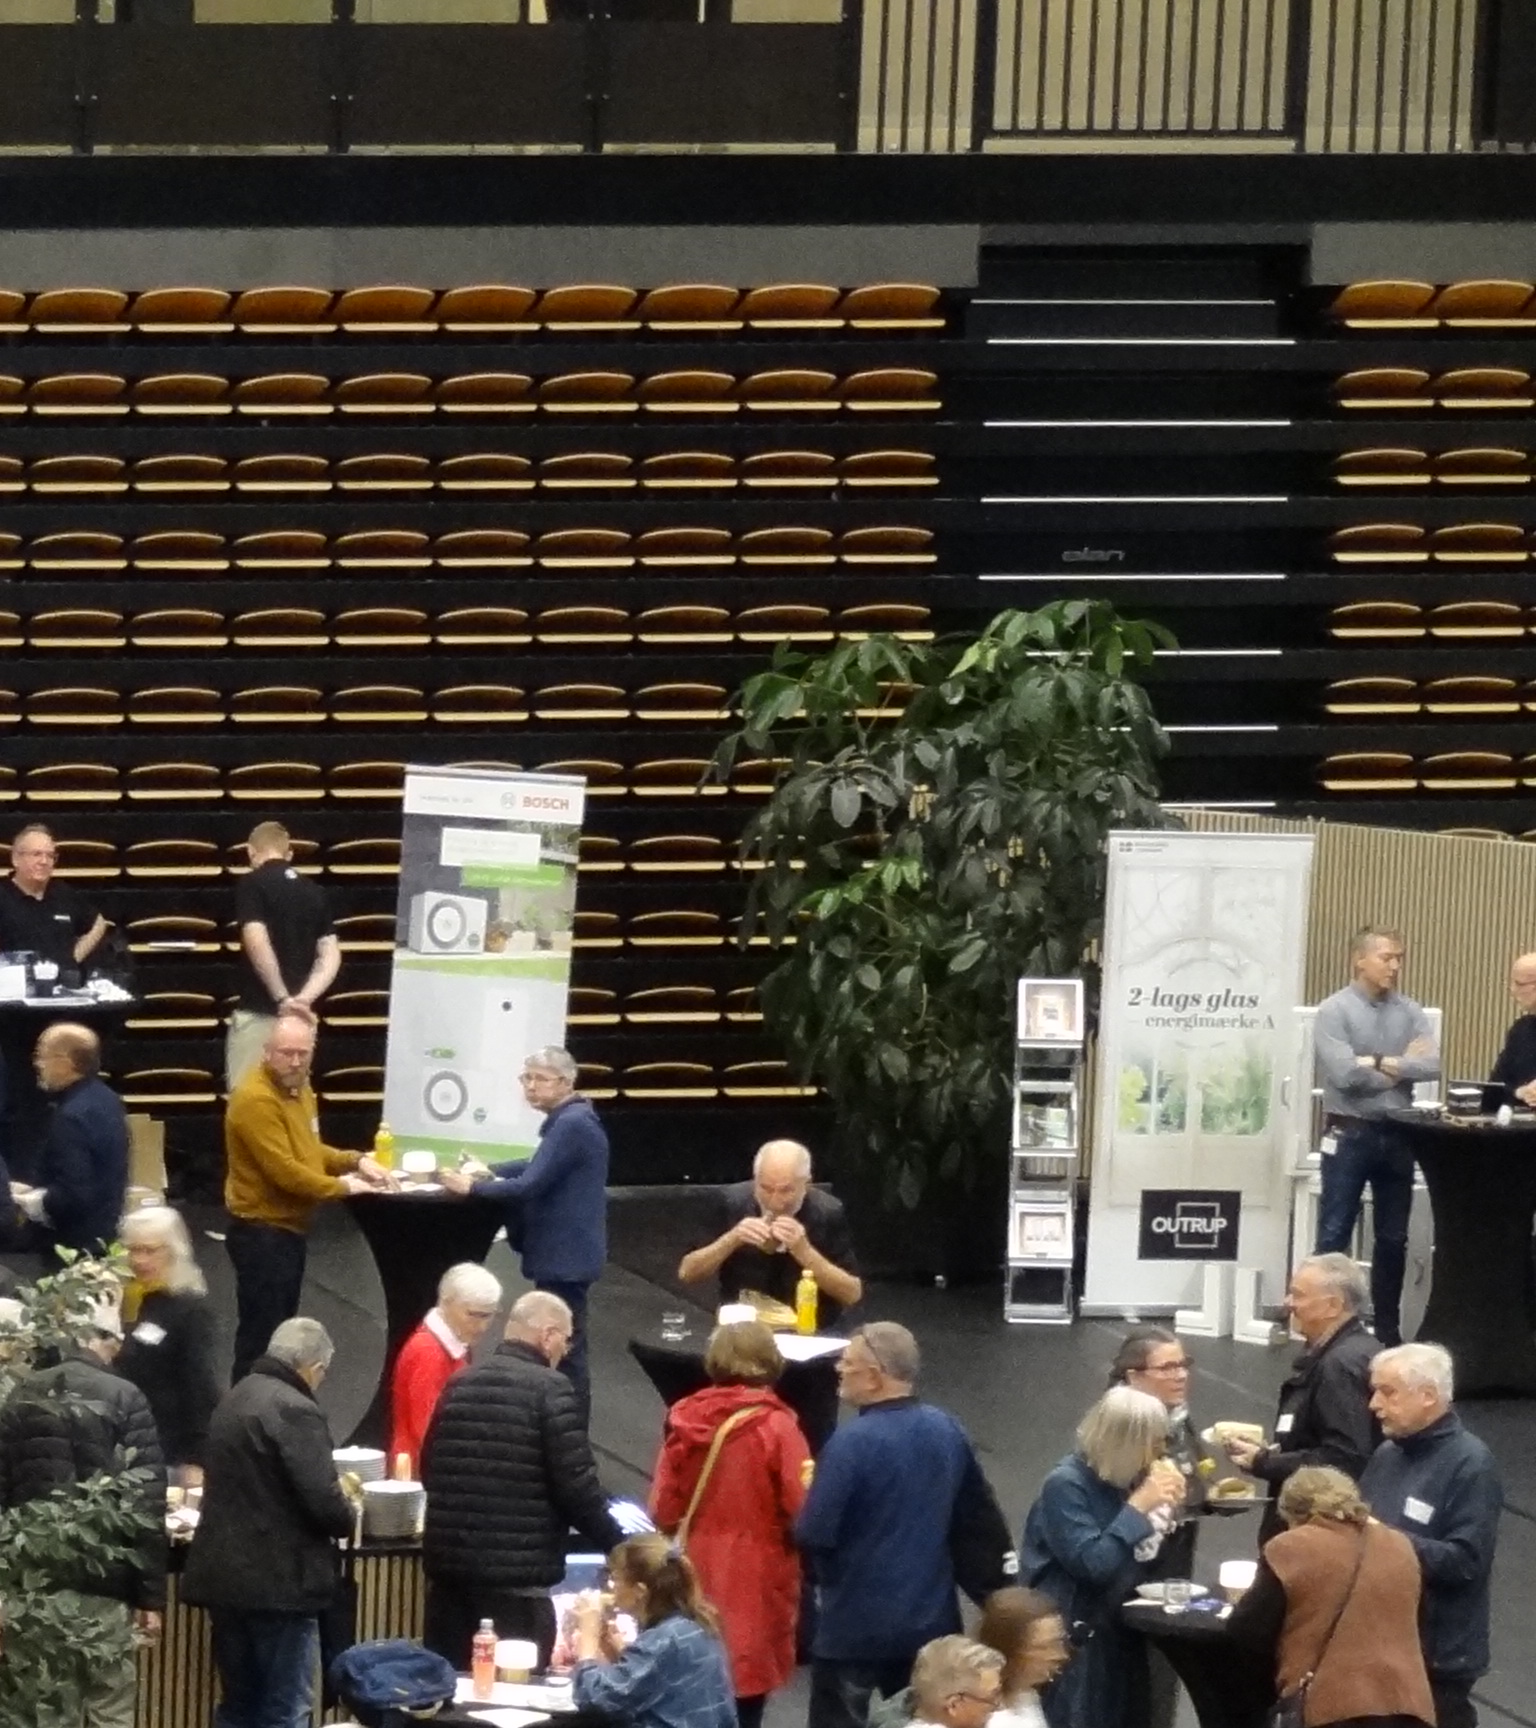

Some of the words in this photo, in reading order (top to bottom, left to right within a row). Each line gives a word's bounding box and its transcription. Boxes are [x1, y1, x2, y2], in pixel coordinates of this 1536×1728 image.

[522, 796, 569, 810] BOSCH
[1128, 986, 1202, 1013] 2-lags
[1206, 988, 1260, 1013] glas
[1145, 1014, 1259, 1032] energimærke
[1262, 1015, 1275, 1029] A
[1152, 1216, 1228, 1233] OUTRUP
